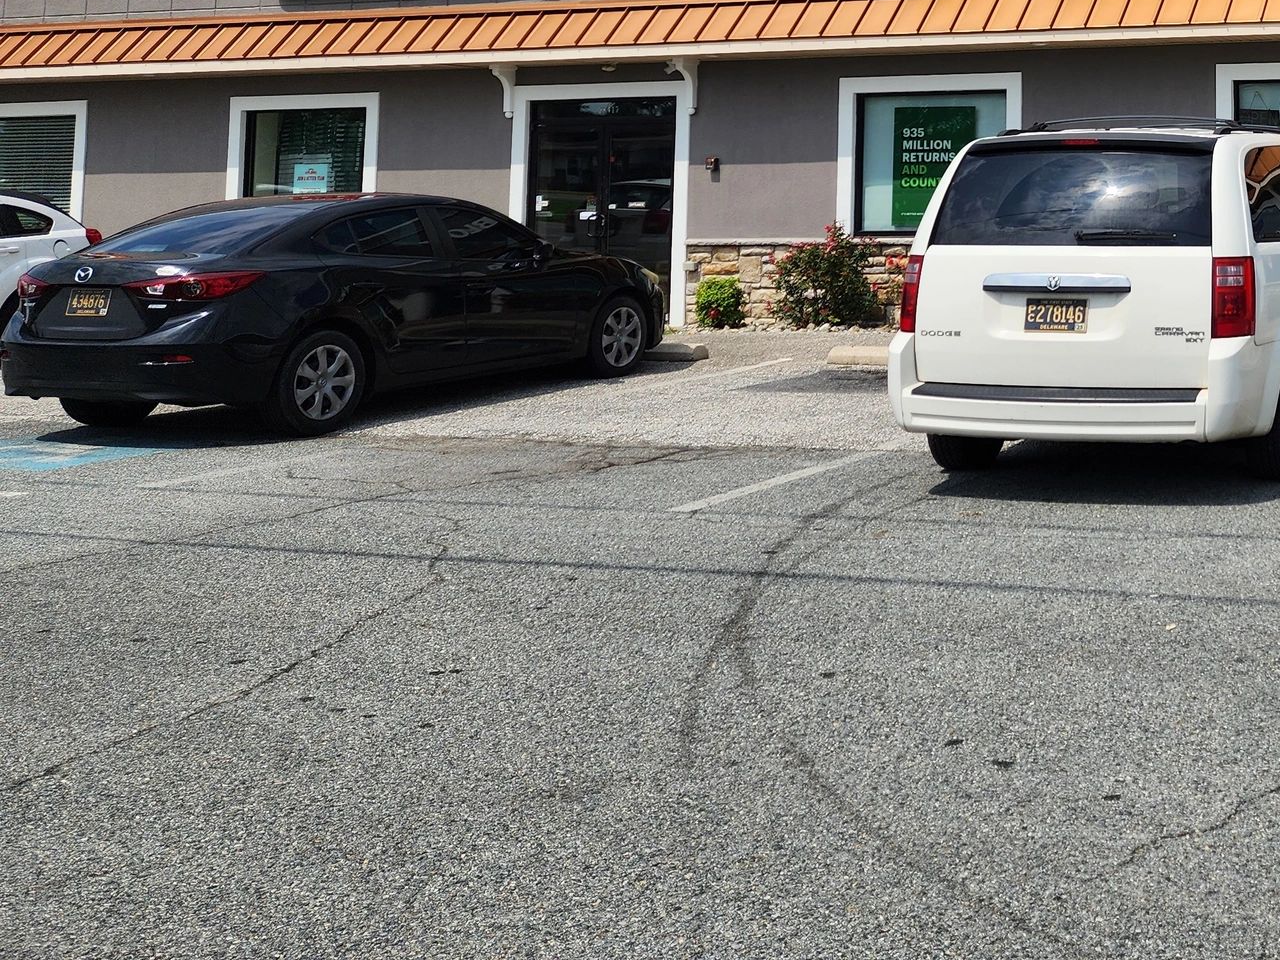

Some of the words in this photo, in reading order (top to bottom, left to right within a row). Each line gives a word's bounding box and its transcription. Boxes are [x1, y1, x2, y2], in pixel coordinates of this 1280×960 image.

[902, 127, 925, 138] 935
[902, 140, 951, 150] MILLION
[902, 152, 956, 162] RETURNS
[902, 165, 927, 175] AND
[72, 294, 105, 308] 434876
